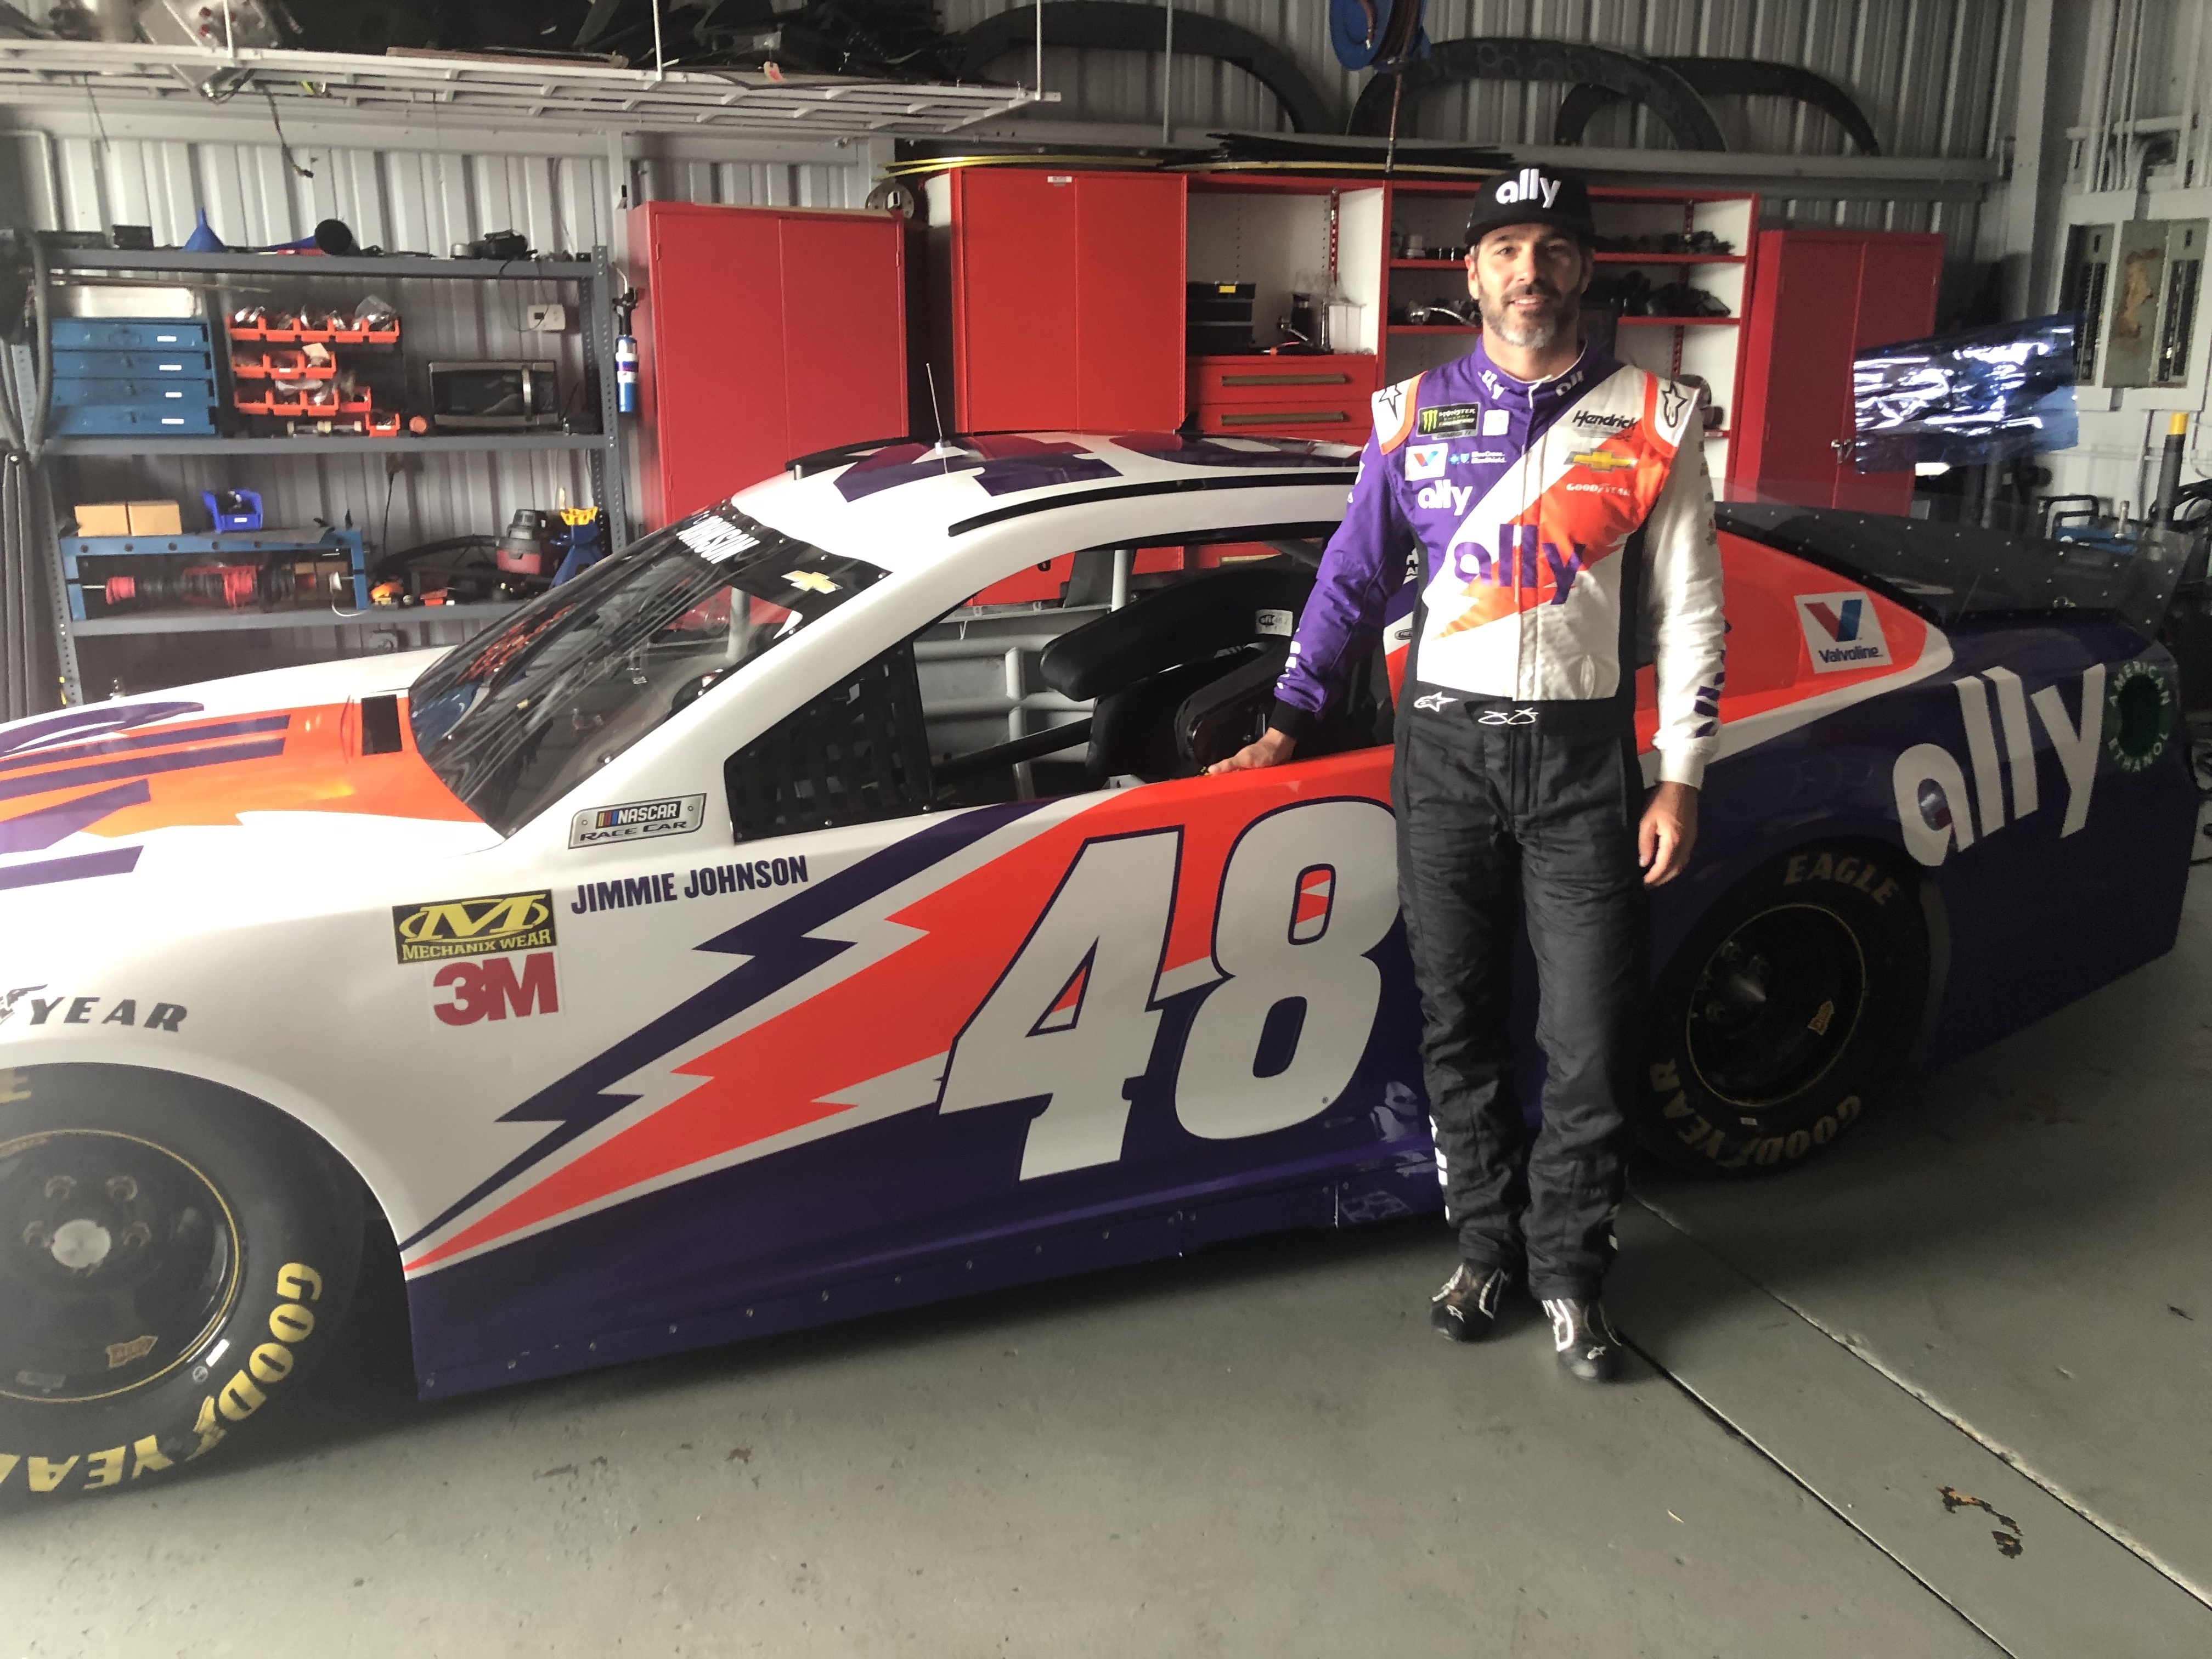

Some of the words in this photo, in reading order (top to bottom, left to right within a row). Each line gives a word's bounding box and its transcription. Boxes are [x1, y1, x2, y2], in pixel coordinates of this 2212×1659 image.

[1496, 168, 1562, 208] ally
[1572, 410, 1638, 431] Hendrick
[1417, 479, 1474, 516] ally
[675, 515, 761, 565] JOHNSON
[1454, 523, 1587, 606] ally
[1818, 645, 1880, 664] Valvoline
[2108, 661, 2171, 706] AMERICAN
[1892, 663, 2106, 867] ally
[2108, 732, 2169, 772] ETHANOL
[579, 827, 637, 842] RACE
[642, 820, 687, 833] CAR
[617, 803, 679, 825] NASCAR
[571, 872, 678, 915] JIMMIE
[684, 855, 809, 899] JOHNSON
[1782, 853, 1899, 906] EAGLE
[402, 940, 496, 961] MECHANIX
[499, 928, 552, 950] WEAR
[433, 951, 559, 1026] 3M
[936, 795, 1400, 1182] 48
[29, 996, 188, 1032] YEAR
